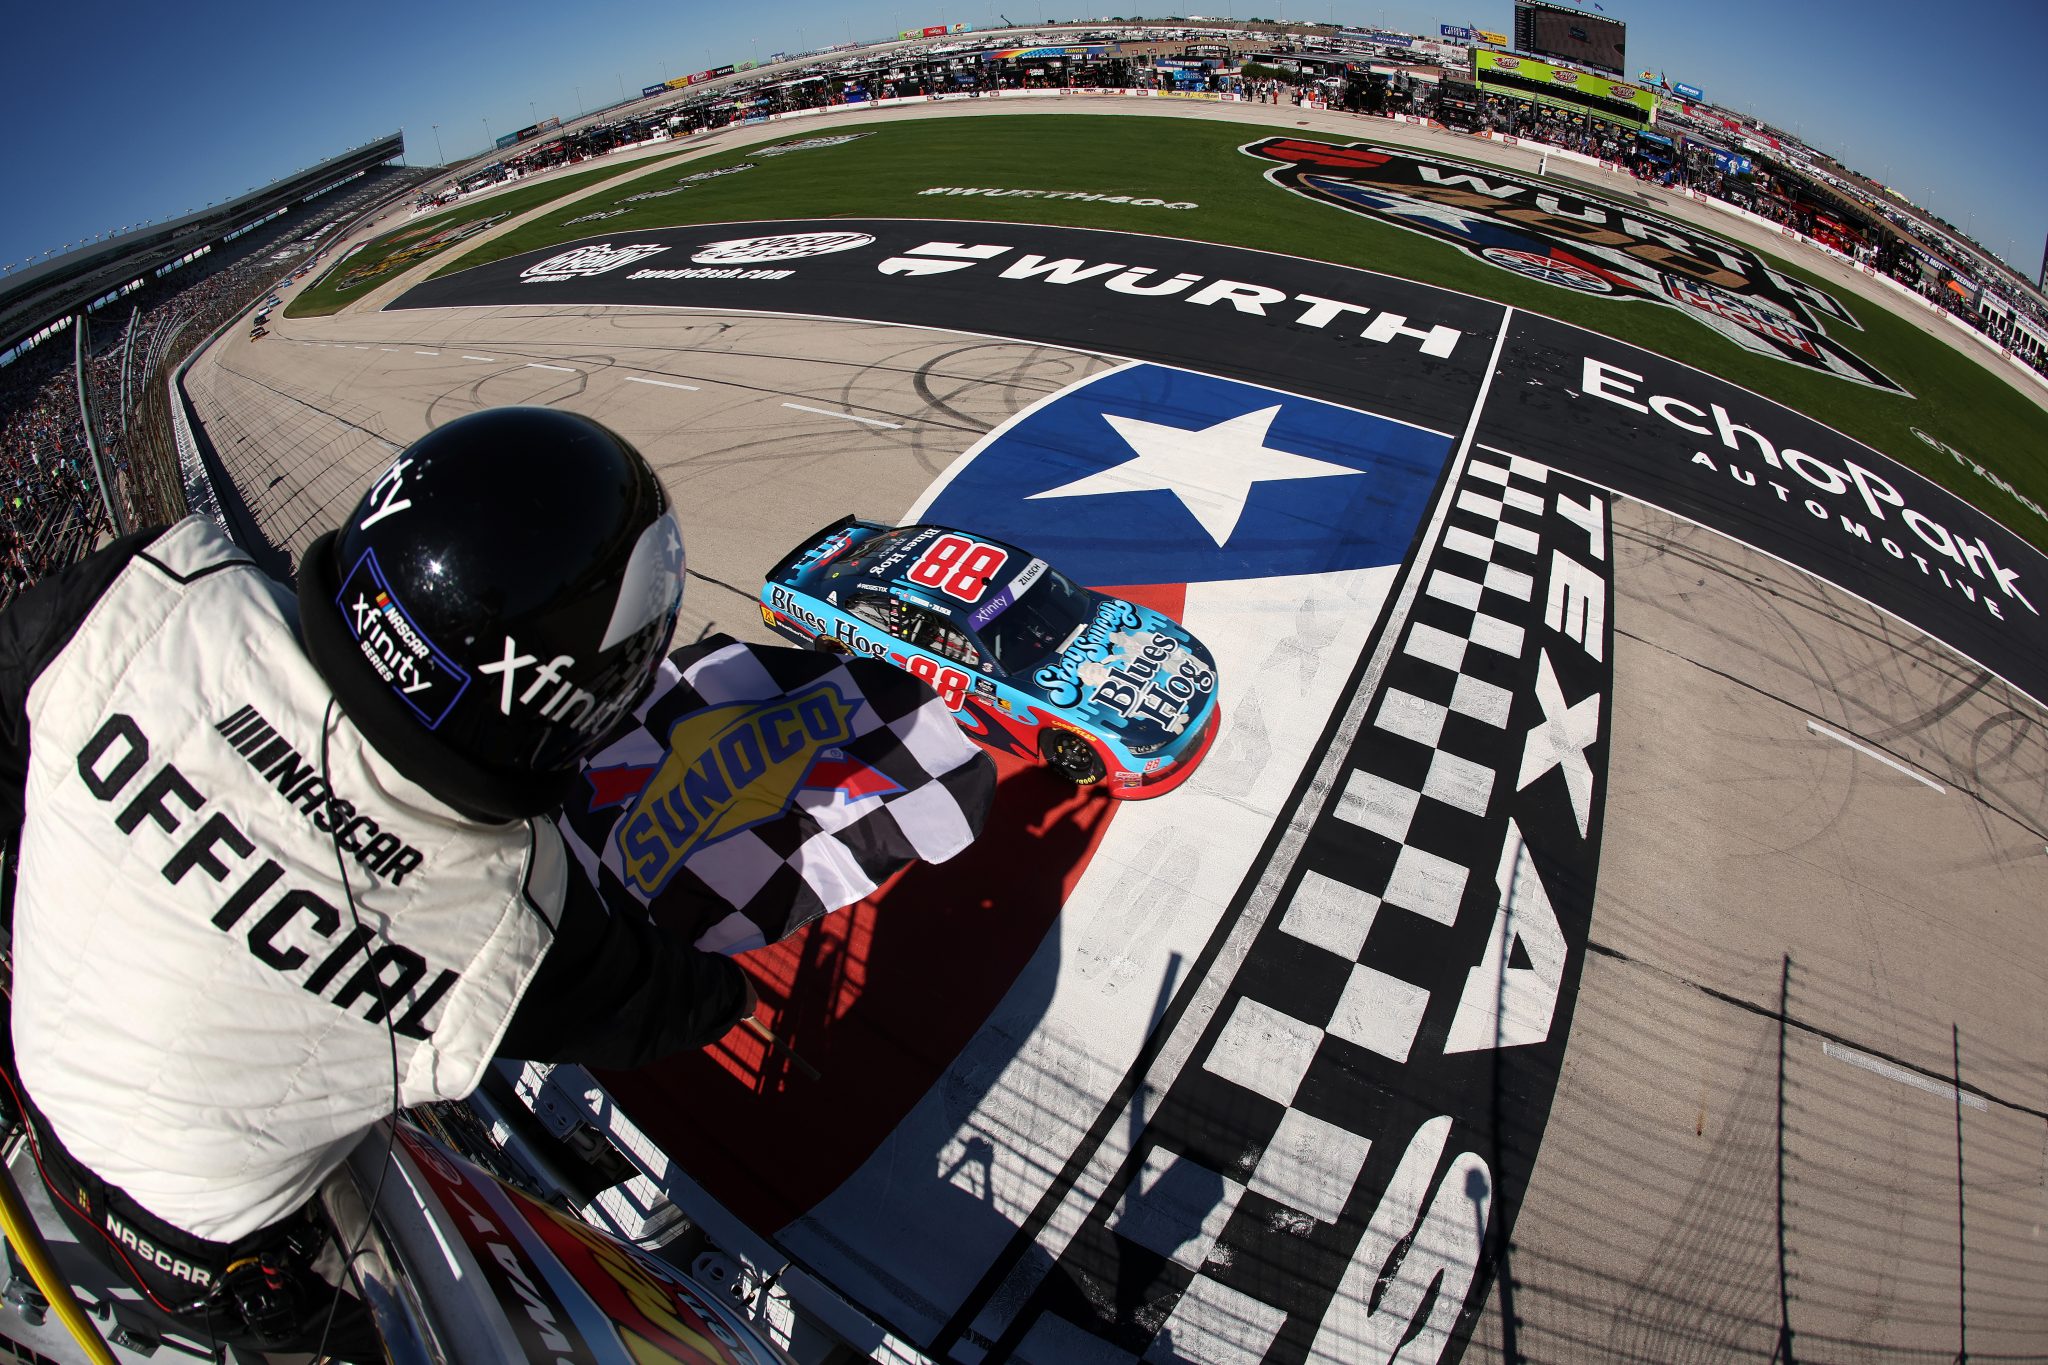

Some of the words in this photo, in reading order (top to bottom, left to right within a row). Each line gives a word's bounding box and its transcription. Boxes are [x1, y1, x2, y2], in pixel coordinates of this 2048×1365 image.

[625, 267, 797, 281] SpeedyCash.com
[1672, 277, 1803, 340] LIQUI
[1674, 287, 1808, 353] MOLY
[1581, 356, 2040, 617] EchoPark
[869, 549, 908, 578] Hog
[901, 528, 942, 553] Blues
[907, 534, 1009, 603] 88
[1690, 451, 2006, 622] AUTOMOTIVE
[771, 586, 828, 635] Blues
[834, 618, 889, 662] Hog
[976, 594, 1009, 622] xfinity
[1018, 563, 1041, 586] ZILISCH
[352, 592, 433, 694] xfinity
[360, 639, 395, 683] SERIES
[385, 607, 430, 659] NASCAR
[906, 654, 971, 713] 88
[1033, 649, 1088, 710] Stay
[1090, 632, 1180, 718] Blues
[1136, 658, 1216, 733] Hog
[263, 751, 425, 887] NASCAR
[625, 693, 842, 883] SUNOCO
[77, 713, 462, 1042] OFFICIAL
[1306, 492, 1606, 1365] TEXAS
[105, 1213, 213, 1289] NASCAR
